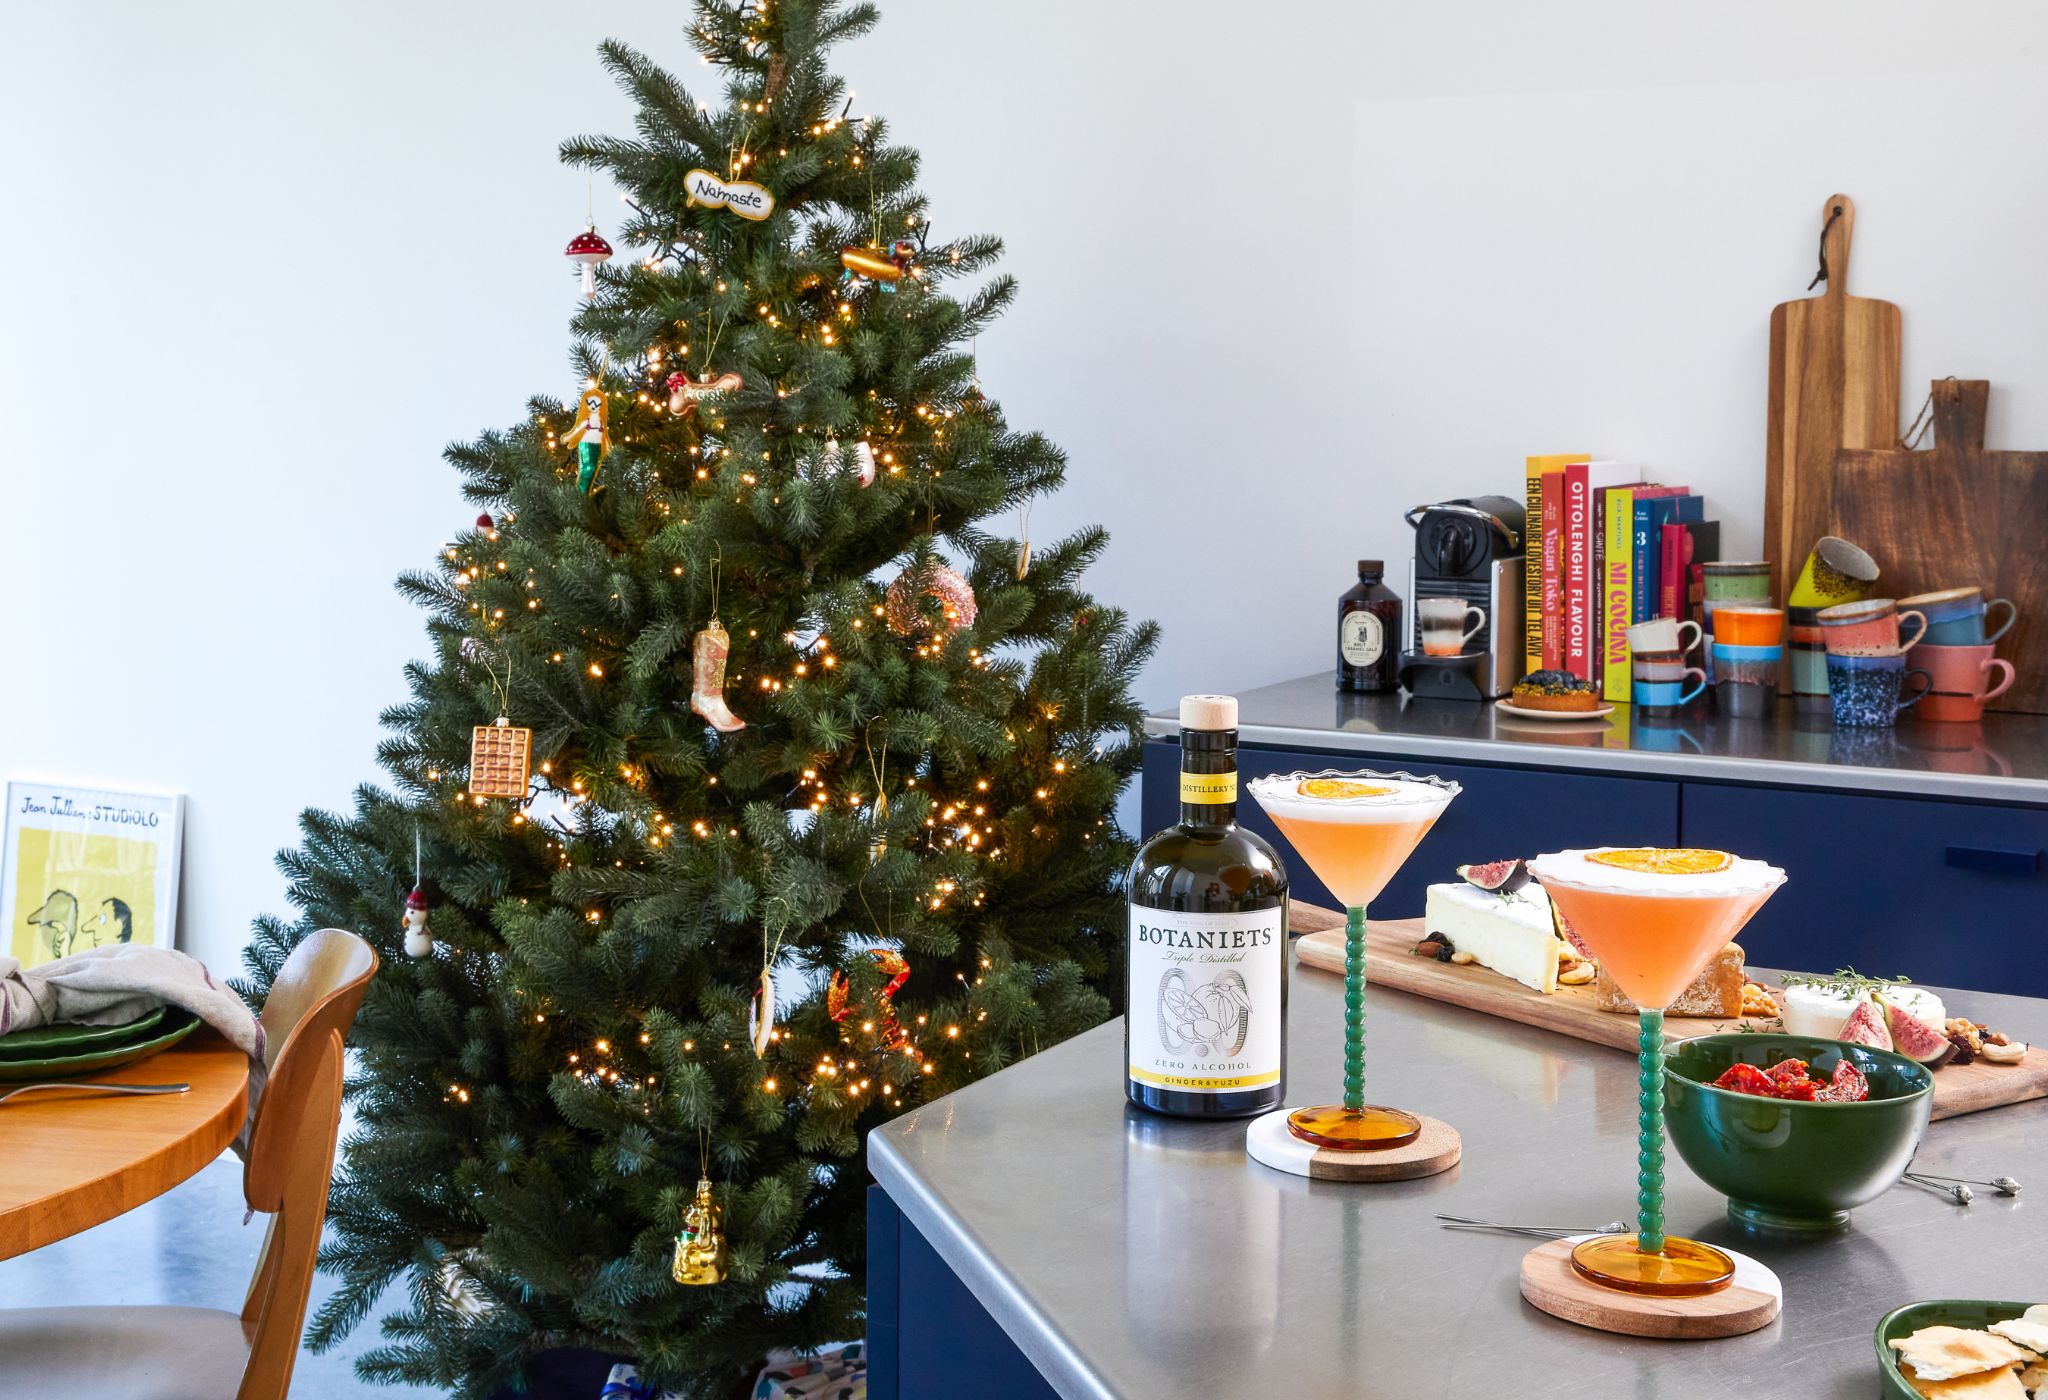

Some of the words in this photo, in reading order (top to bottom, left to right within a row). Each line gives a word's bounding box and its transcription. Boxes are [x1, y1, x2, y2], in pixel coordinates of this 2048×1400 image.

[695, 179, 762, 209] Namaste
[1526, 477, 1541, 494] EEN
[1526, 496, 1541, 545] CULINAIRE
[1571, 481, 1584, 581] OTTOLENGHI
[1544, 527, 1558, 572] Vegan
[1636, 531, 1647, 546] 3
[1526, 545, 1541, 598] LOVESTORY
[1609, 561, 1628, 585] MI
[1545, 575, 1558, 611] Toko
[1526, 599, 1541, 614] UIT
[1526, 618, 1541, 635] TEL
[1571, 588, 1584, 657] FLAVOUR
[1609, 589, 1628, 665] COCINA
[1526, 635, 1541, 658] AVIV
[1182, 783, 1229, 793] DISTILLERY
[21, 797, 47, 814] Jean
[49, 796, 86, 819] Jullien
[1139, 924, 1271, 949] BOTANIETS
[1161, 950, 1194, 966] Triple
[1199, 951, 1247, 965] Distilled
[1155, 1059, 1185, 1069] ZERO
[1192, 1062, 1251, 1071] ALCOHOL
[1164, 1077, 1240, 1086] GINGER&YUZU
